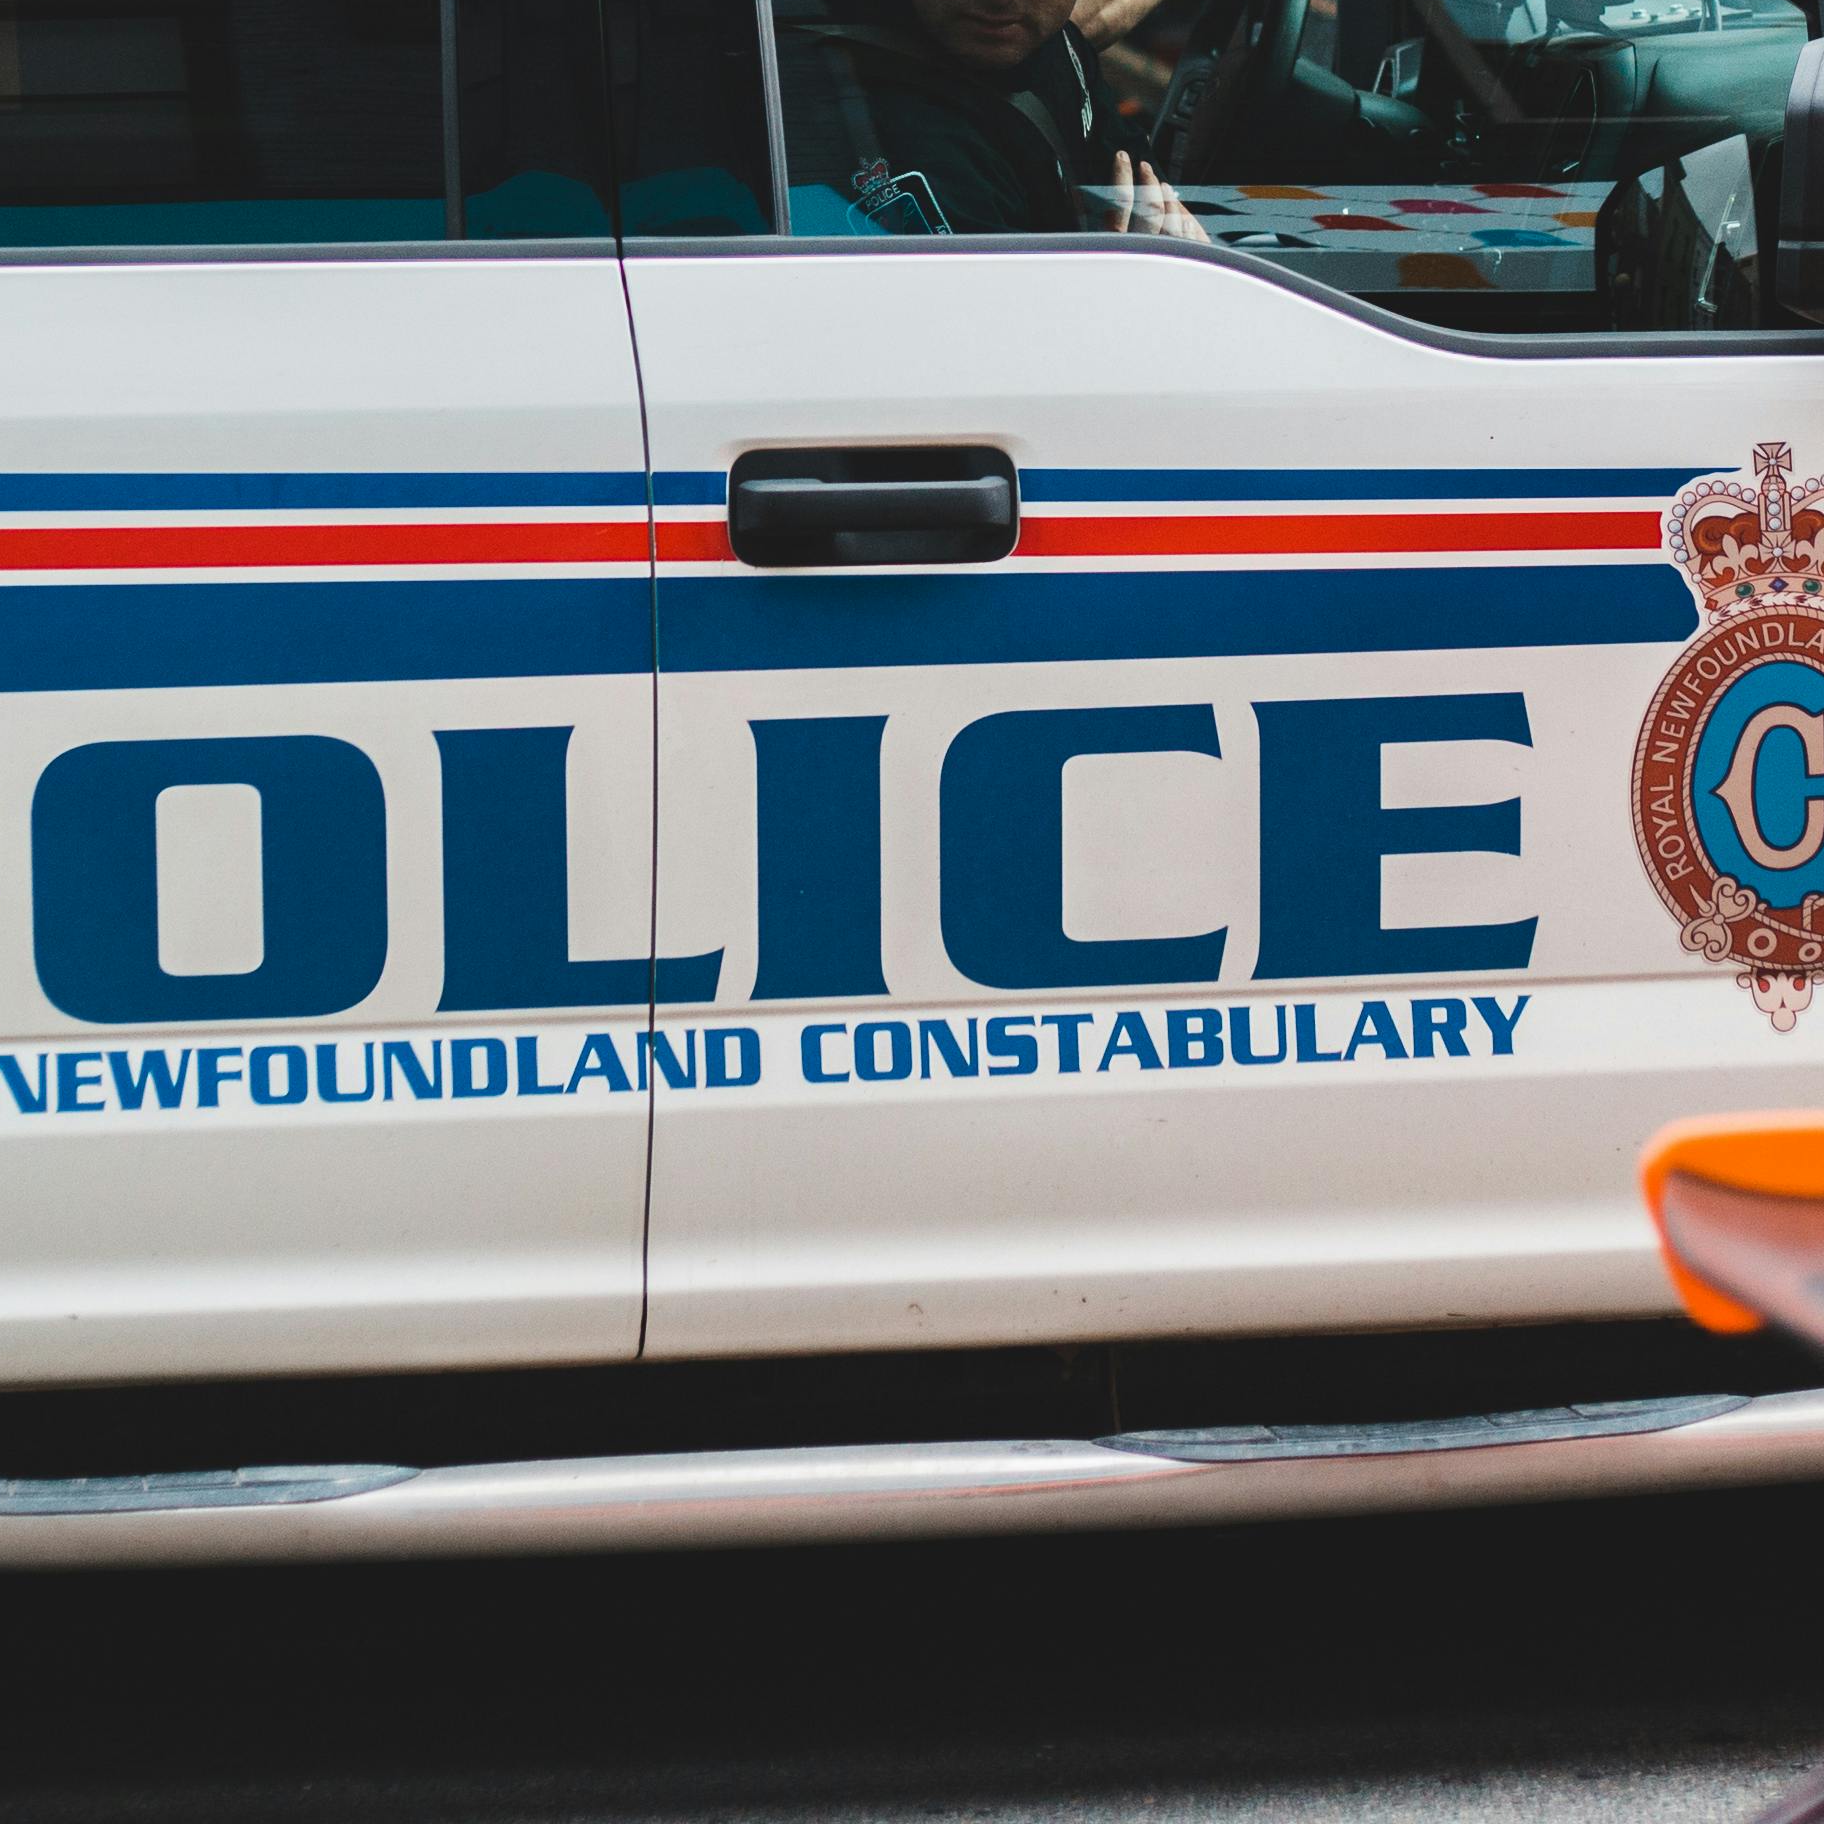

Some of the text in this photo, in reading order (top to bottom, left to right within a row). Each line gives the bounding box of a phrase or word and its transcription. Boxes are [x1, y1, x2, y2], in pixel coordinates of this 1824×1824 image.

[866, 183, 901, 208] POLICE
[1649, 775, 1694, 881] ROYAL
[800, 995, 1531, 1086] CONSTABULARY
